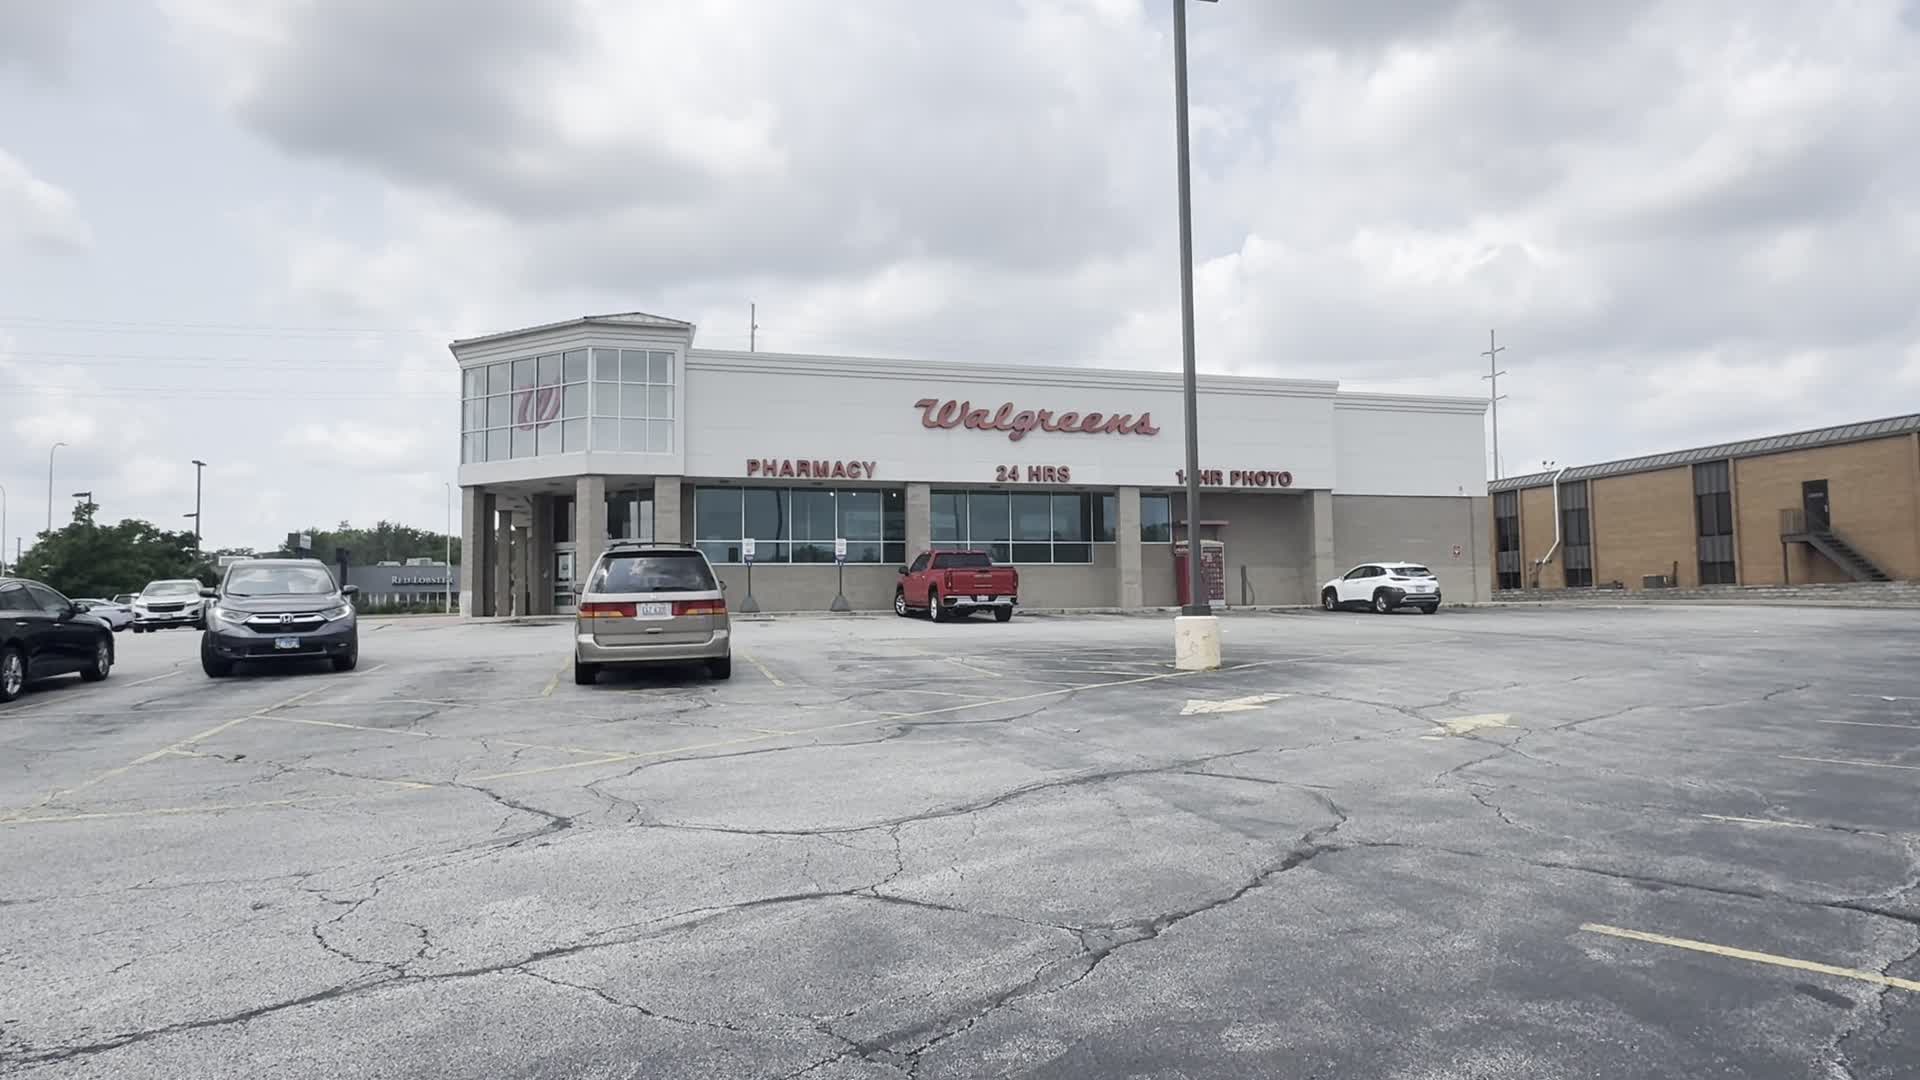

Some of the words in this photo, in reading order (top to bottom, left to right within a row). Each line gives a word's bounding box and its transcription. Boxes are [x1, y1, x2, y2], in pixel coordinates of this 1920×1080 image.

[914, 398, 1161, 441] Walgreens
[746, 459, 877, 479] PHARMACY
[995, 464, 1020, 482] 24
[1028, 465, 1071, 483] HRS
[1230, 470, 1293, 487] PHOTO
